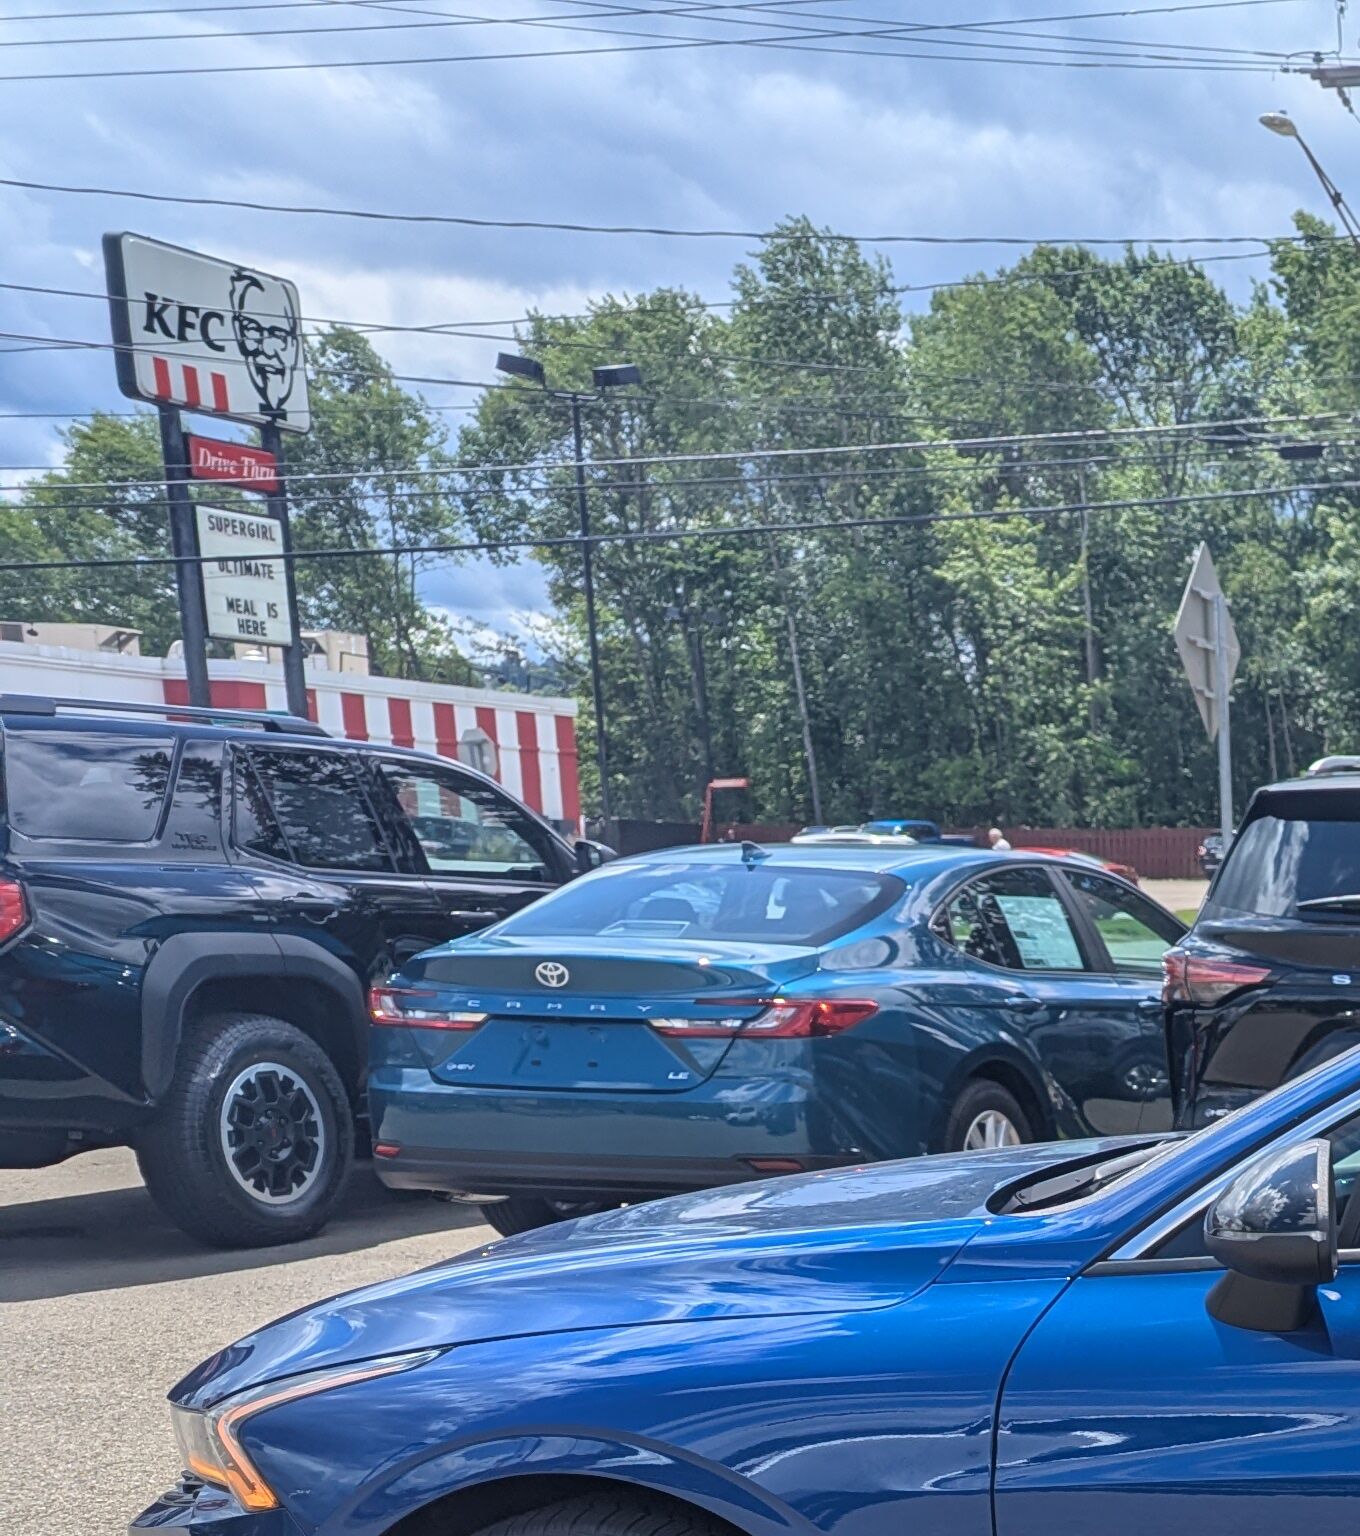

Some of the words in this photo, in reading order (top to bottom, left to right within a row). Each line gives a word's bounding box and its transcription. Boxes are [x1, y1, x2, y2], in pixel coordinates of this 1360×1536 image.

[143, 291, 226, 353] KFC
[198, 447, 237, 475] Drive
[241, 456, 276, 480] Thru
[207, 514, 276, 542] SUPERGIRL
[218, 559, 275, 580] ULTIMATE
[225, 596, 258, 617] MEAL
[267, 602, 279, 619] IS
[237, 618, 267, 637] HERE
[467, 999, 653, 1013] CAMRY
